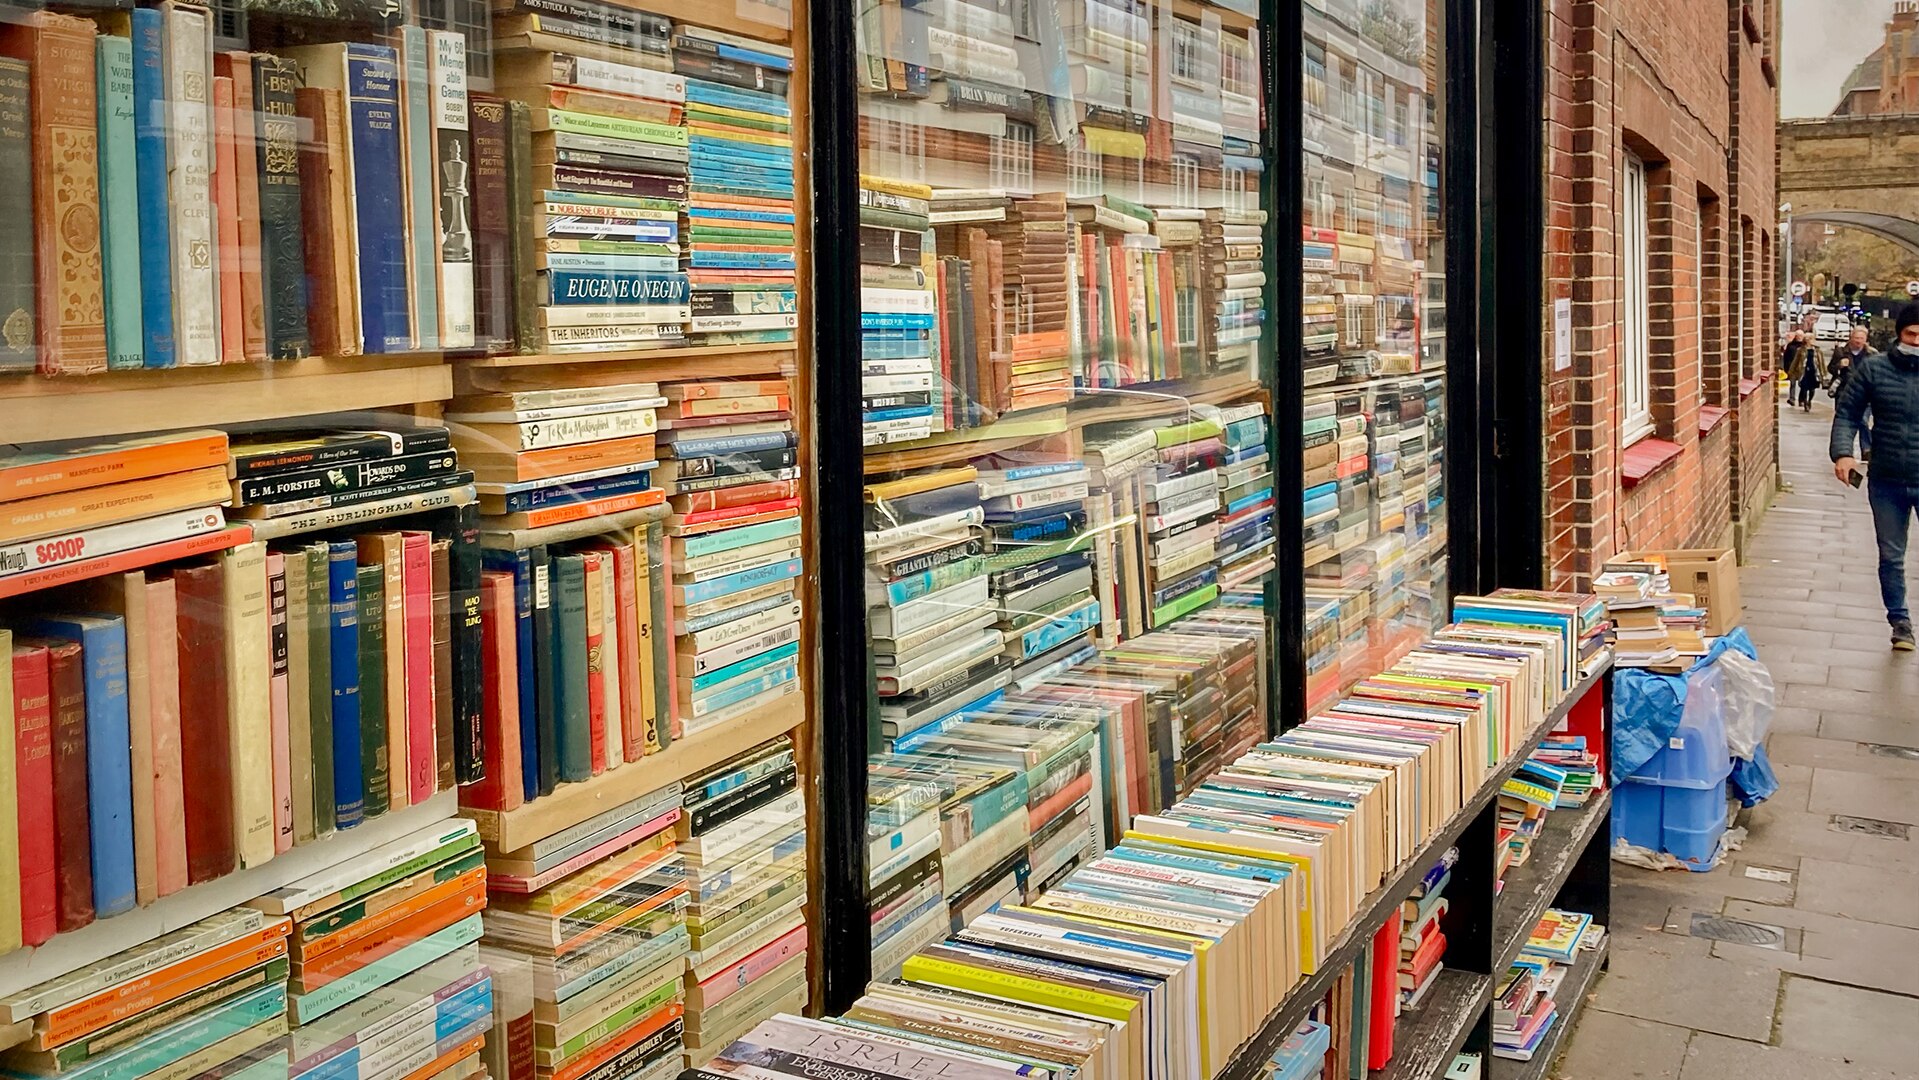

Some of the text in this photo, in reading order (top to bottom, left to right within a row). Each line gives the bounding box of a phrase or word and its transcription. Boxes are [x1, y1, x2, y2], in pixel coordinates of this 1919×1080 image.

[439, 40, 464, 55] My 60
[446, 71, 461, 84] able
[441, 85, 466, 99] Games
[567, 279, 686, 299] EUGENE ONEGIN
[551, 329, 569, 341] THE
[570, 327, 620, 340] INHERITORS
[107, 463, 124, 472] PARK
[249, 478, 321, 498] E. M. FORSTER
[82, 502, 104, 512] GREAT
[106, 493, 154, 508] EXPECTATIONS
[291, 495, 450, 530] THE HURLINGHAM CLUB
[35, 537, 85, 565] SCOOP
[896, 555, 934, 577] GHASTLY
[464, 596, 480, 608] MAO
[467, 607, 478, 616] TSE
[465, 616, 482, 627] TUNG
[1080, 904, 1198, 929] ROBERT WINSTON
[1000, 926, 1043, 938] SUPERNOVA
[304, 982, 356, 1015] JOSEPH CONRAD
[112, 1007, 126, 1018] The
[904, 1019, 1002, 1045] The Three Clerks
[970, 1021, 993, 1030] YEAR
[834, 1026, 911, 1046] SMART RETAIL
[619, 1050, 639, 1067] JOHN
[805, 1034, 959, 1078] ISRAEL
